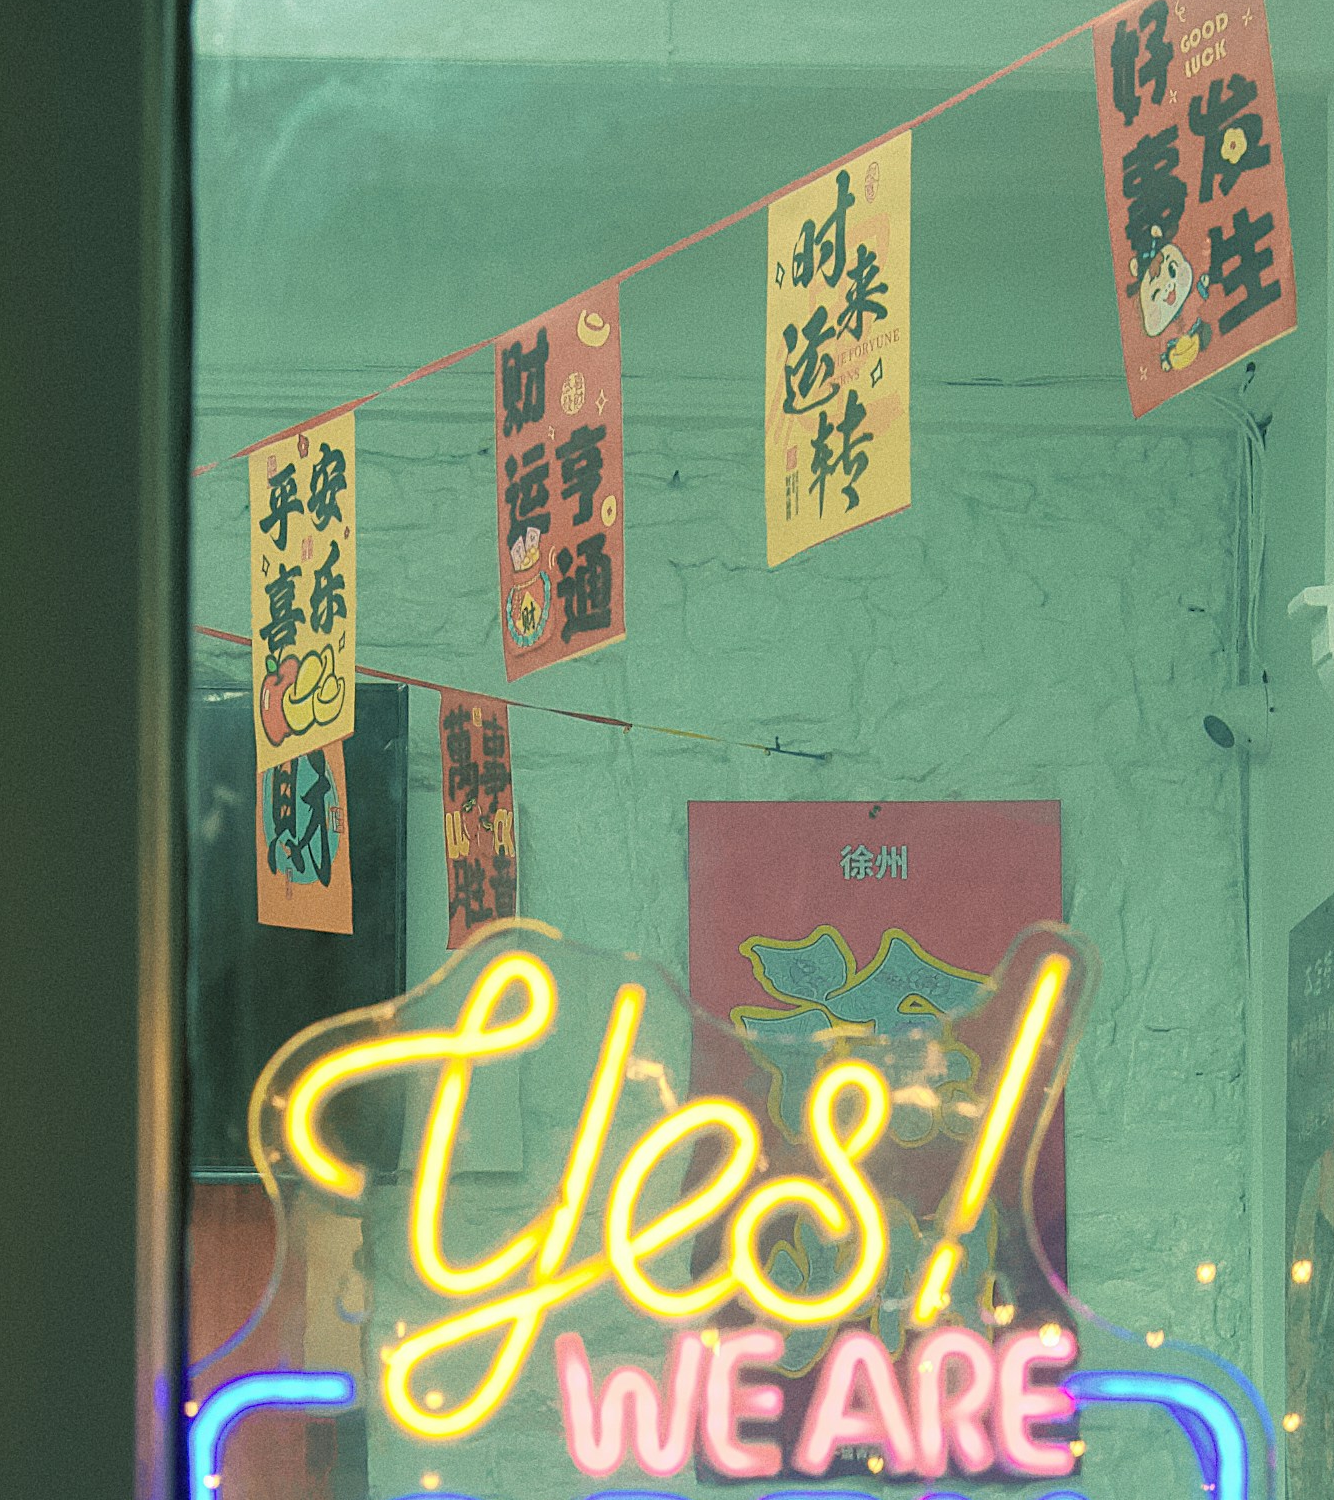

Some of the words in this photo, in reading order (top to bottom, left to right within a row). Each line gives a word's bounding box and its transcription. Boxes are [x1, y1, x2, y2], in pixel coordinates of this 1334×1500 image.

[1179, 11, 1229, 54] GOOD
[1184, 39, 1228, 79] LUCK
[258, 442, 349, 552] 平安
[261, 539, 349, 654] 喜乐
[839, 844, 909, 881] 徐州
[285, 950, 1073, 1442] Yes!
[556, 1328, 784, 1478] WE
[795, 1328, 1082, 1478] ARE
